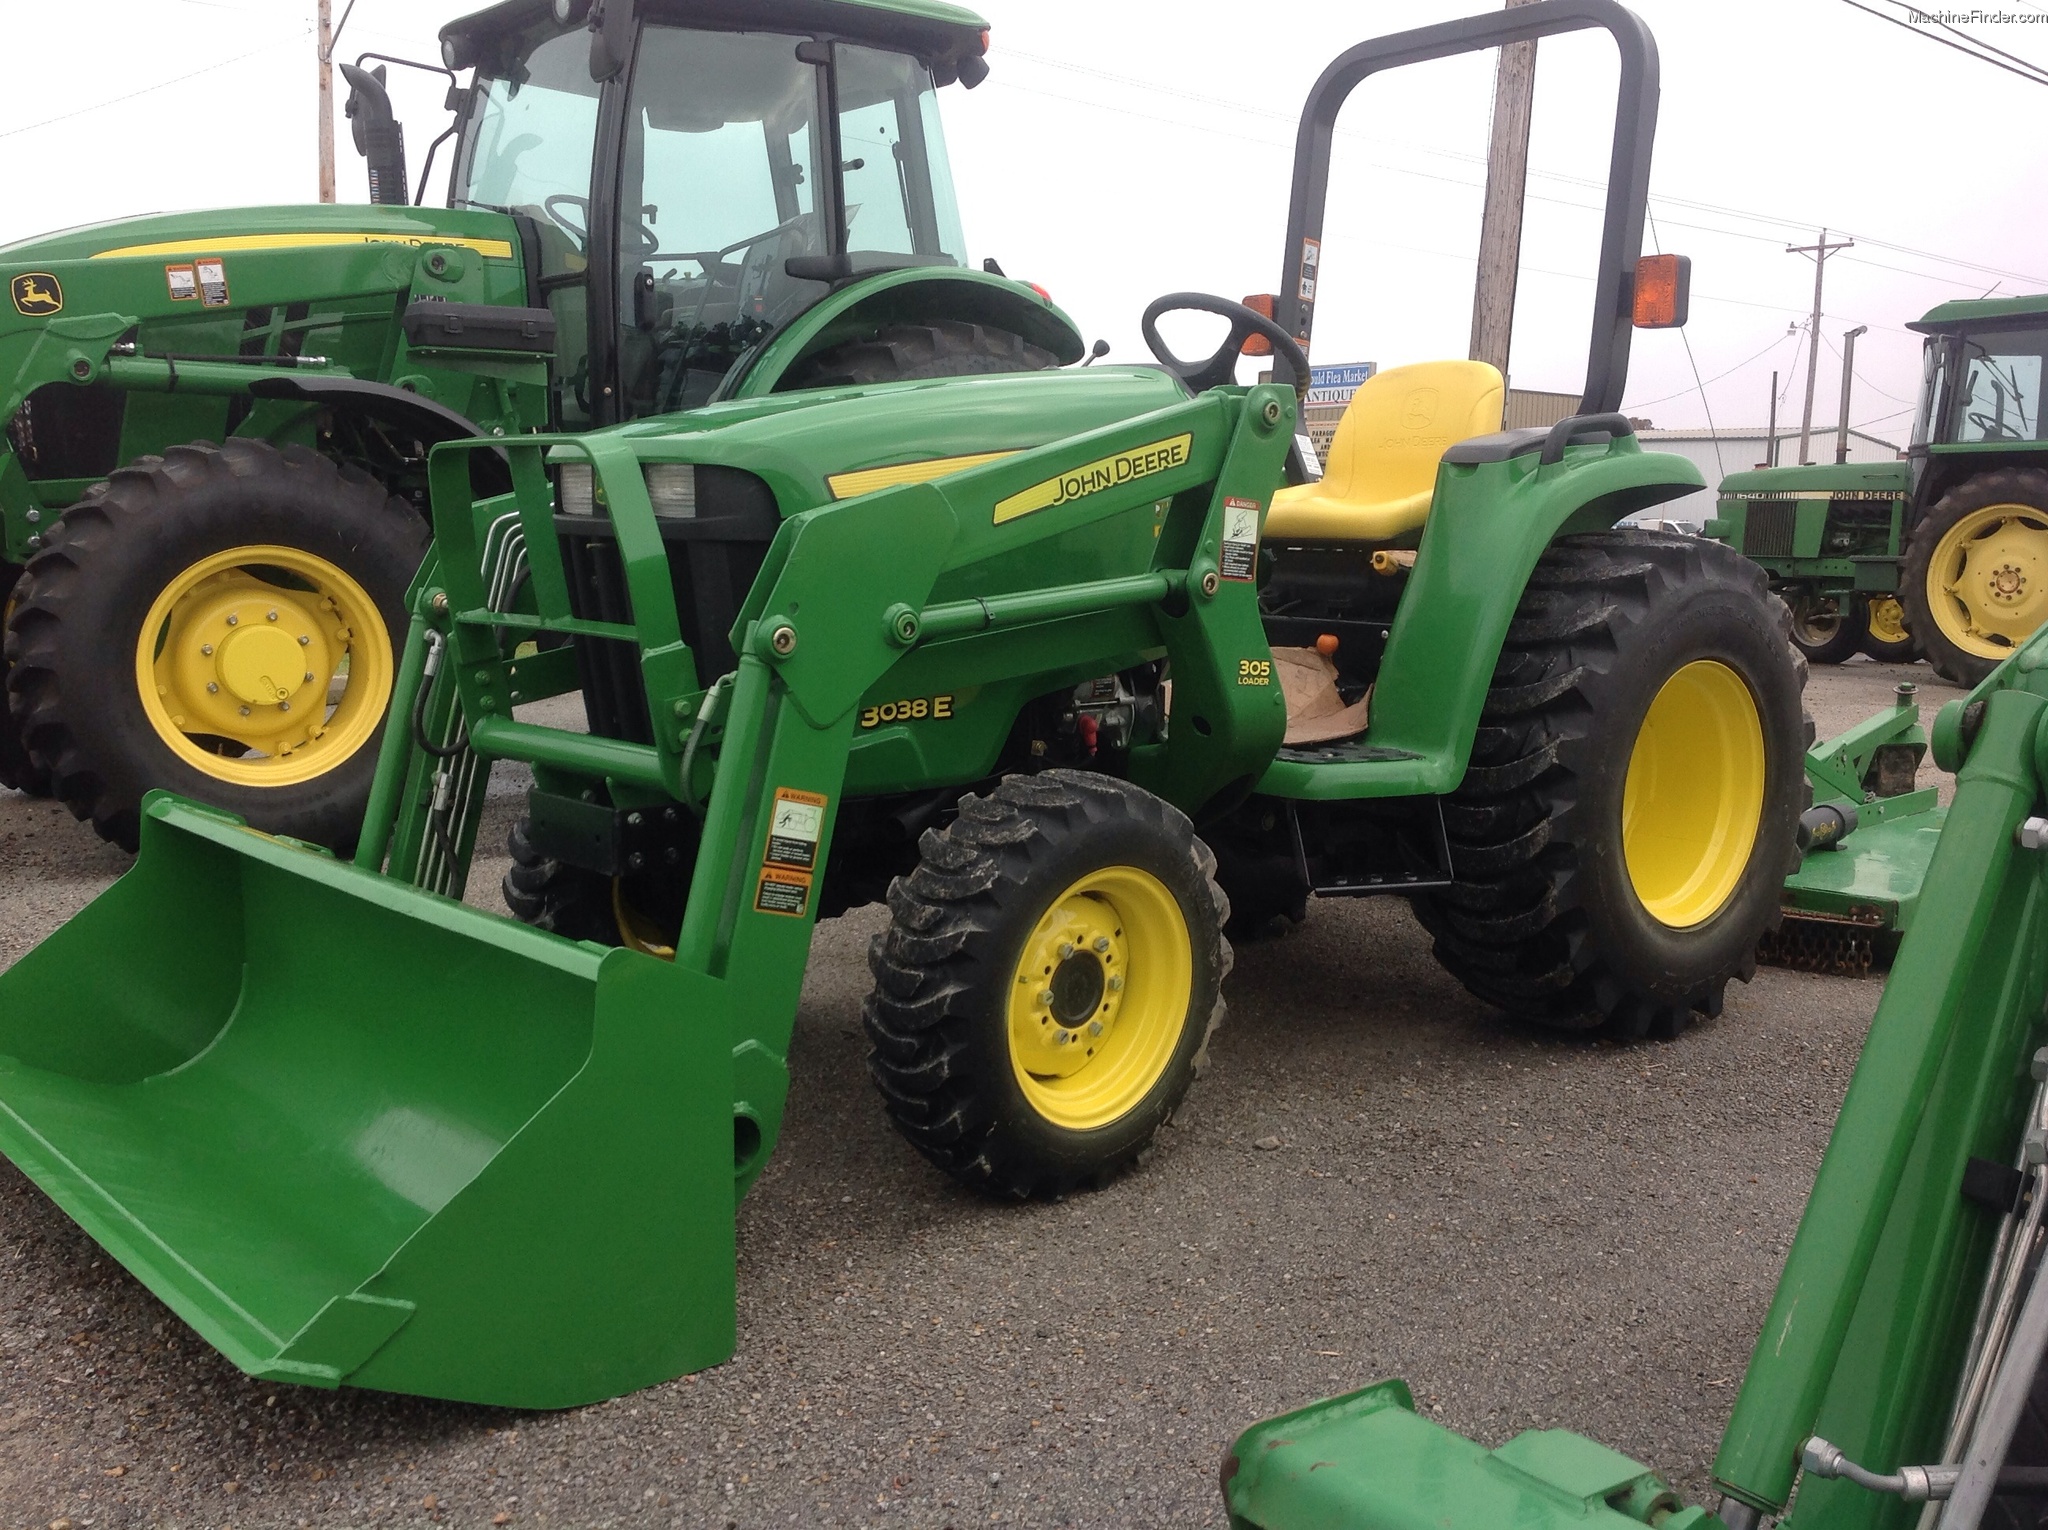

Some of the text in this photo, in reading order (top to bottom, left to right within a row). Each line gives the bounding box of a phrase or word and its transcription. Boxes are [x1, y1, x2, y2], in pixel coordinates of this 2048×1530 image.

[1326, 370, 1341, 384] Flea
[1342, 369, 1368, 383] Market
[1053, 444, 1184, 505] JOHN DEERE
[1829, 490, 1902, 501] JOHN DEERE
[1239, 659, 1271, 676] 305
[1238, 676, 1270, 686] LOADER
[790, 793, 821, 805] WARNING
